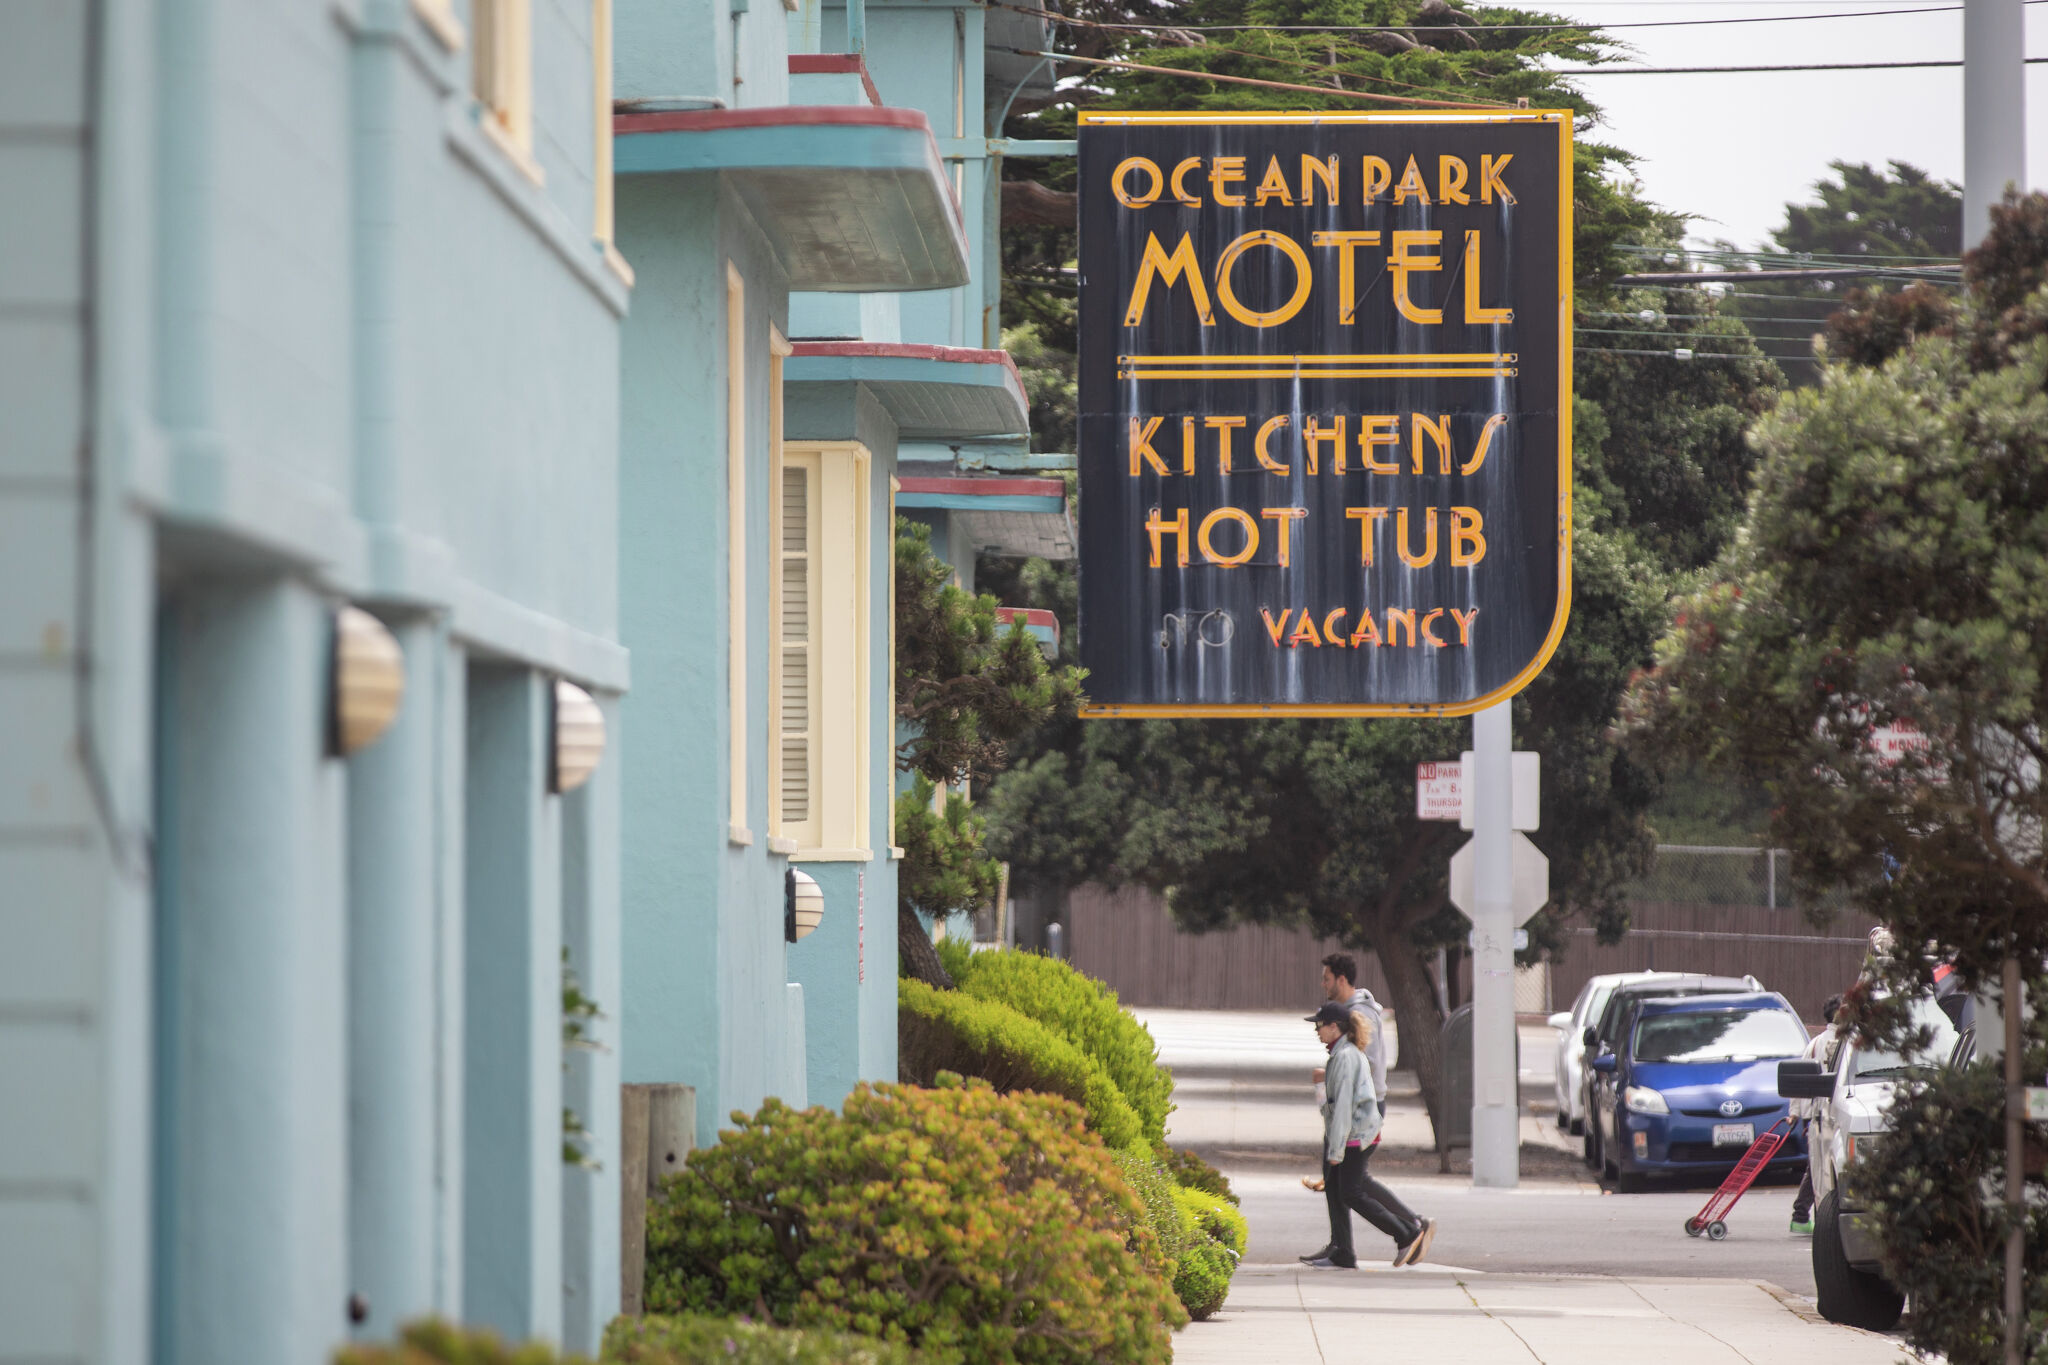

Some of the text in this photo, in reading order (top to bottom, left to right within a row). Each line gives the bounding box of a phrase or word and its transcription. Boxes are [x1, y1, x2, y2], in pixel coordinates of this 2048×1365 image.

[1111, 153, 1518, 209] OCEAN PARK
[1123, 229, 1514, 328] MOTEL
[1129, 413, 1509, 477] KITCHENS
[1145, 506, 1487, 569] HOT TUB
[1160, 606, 1480, 649] NO VACANCY
[1420, 765, 1462, 779] NO PARKI
[1427, 797, 1462, 808] THURSDA
